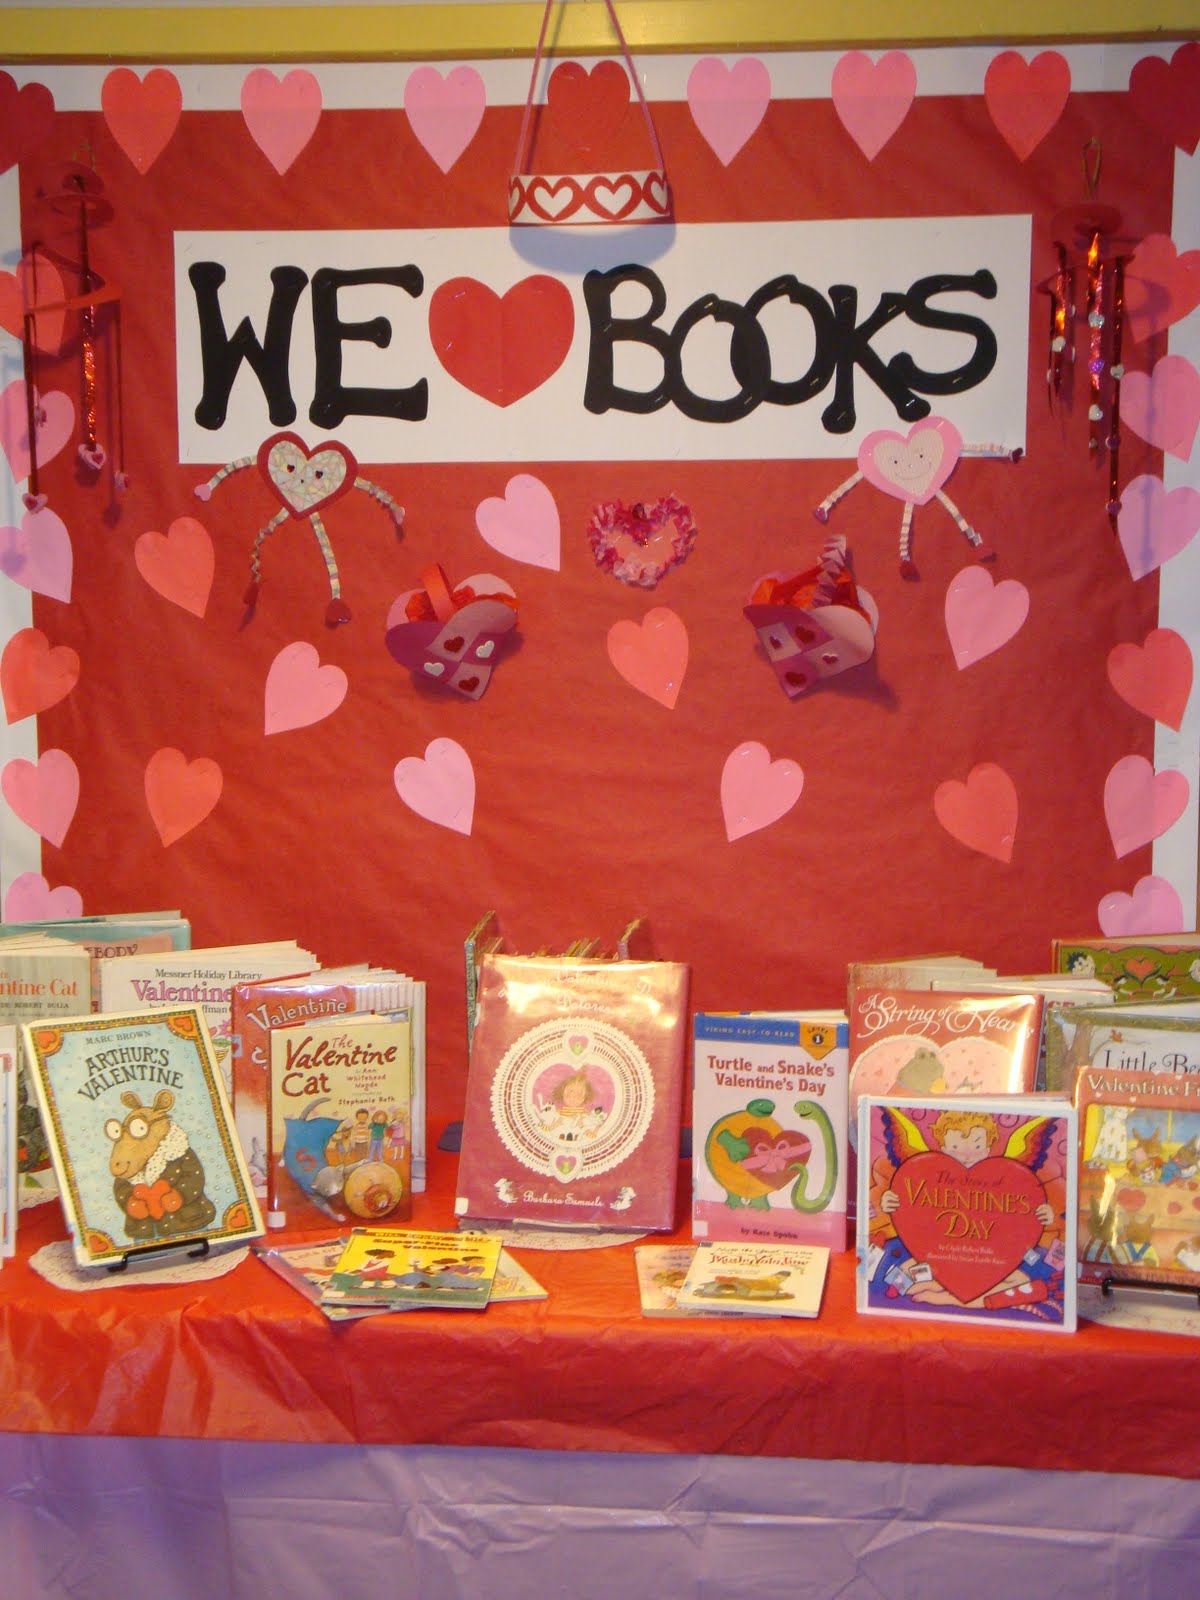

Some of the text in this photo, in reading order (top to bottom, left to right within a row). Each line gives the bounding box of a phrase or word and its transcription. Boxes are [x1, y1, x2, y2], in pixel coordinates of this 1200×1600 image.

[188, 262, 998, 432] WE BOOKS
[155, 969, 262, 980] Messner Holiday Library
[50, 978, 78, 996] Cat
[246, 998, 347, 1031] Valentine
[857, 992, 1034, 1038] A String of Hears
[85, 1030, 152, 1045] MARC BROWN
[332, 1034, 353, 1048] The
[705, 1026, 734, 1034] VIKING
[85, 1047, 170, 1077] ARTHUR'S
[286, 1036, 398, 1071] Valentine
[707, 1055, 835, 1077] Turtle and Snake's
[77, 1065, 184, 1101] VALENTINE
[281, 1072, 331, 1097] Cat
[715, 1073, 827, 1097] Valentine's Day
[1087, 1074, 1179, 1096] Valentine
[338, 1098, 375, 1108] Stephanie
[936, 1169, 956, 1185] The
[523, 1190, 604, 1207] Barbara Samuels
[904, 1176, 1031, 1215] VALENTINE'S
[741, 1227, 750, 1236] by
[935, 1209, 995, 1240] DAY
